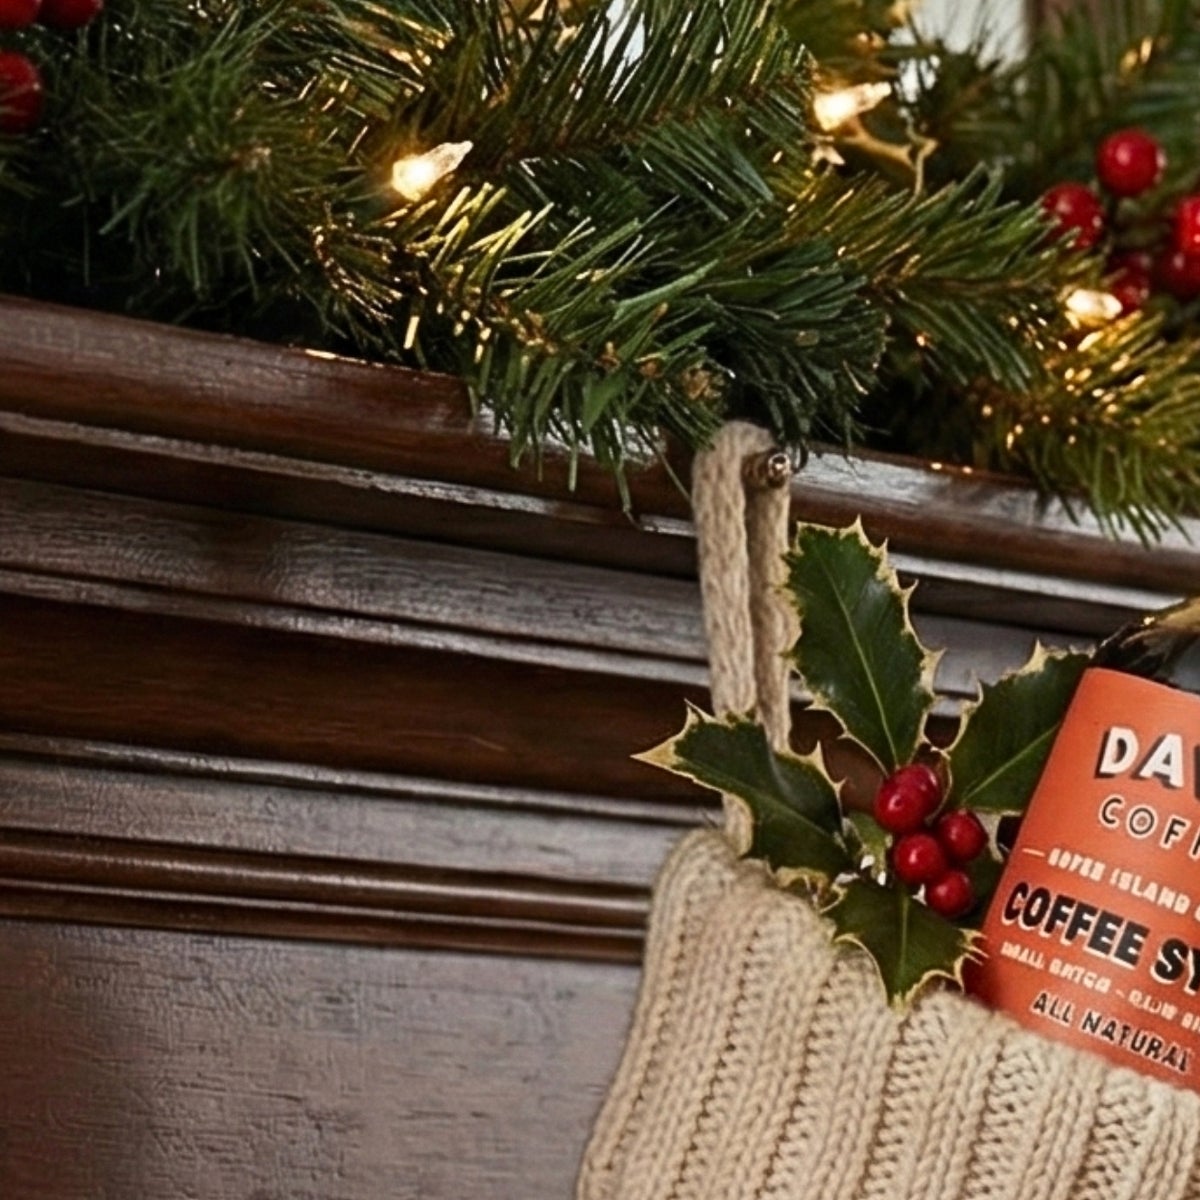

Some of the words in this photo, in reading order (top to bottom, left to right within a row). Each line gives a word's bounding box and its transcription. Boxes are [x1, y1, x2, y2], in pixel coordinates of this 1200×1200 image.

[1001, 881, 1150, 969] COFFEE
[1110, 868, 1191, 915] ISLAND
[1030, 992, 1074, 1027] ALL
[1081, 1005, 1192, 1075] NATURAL
